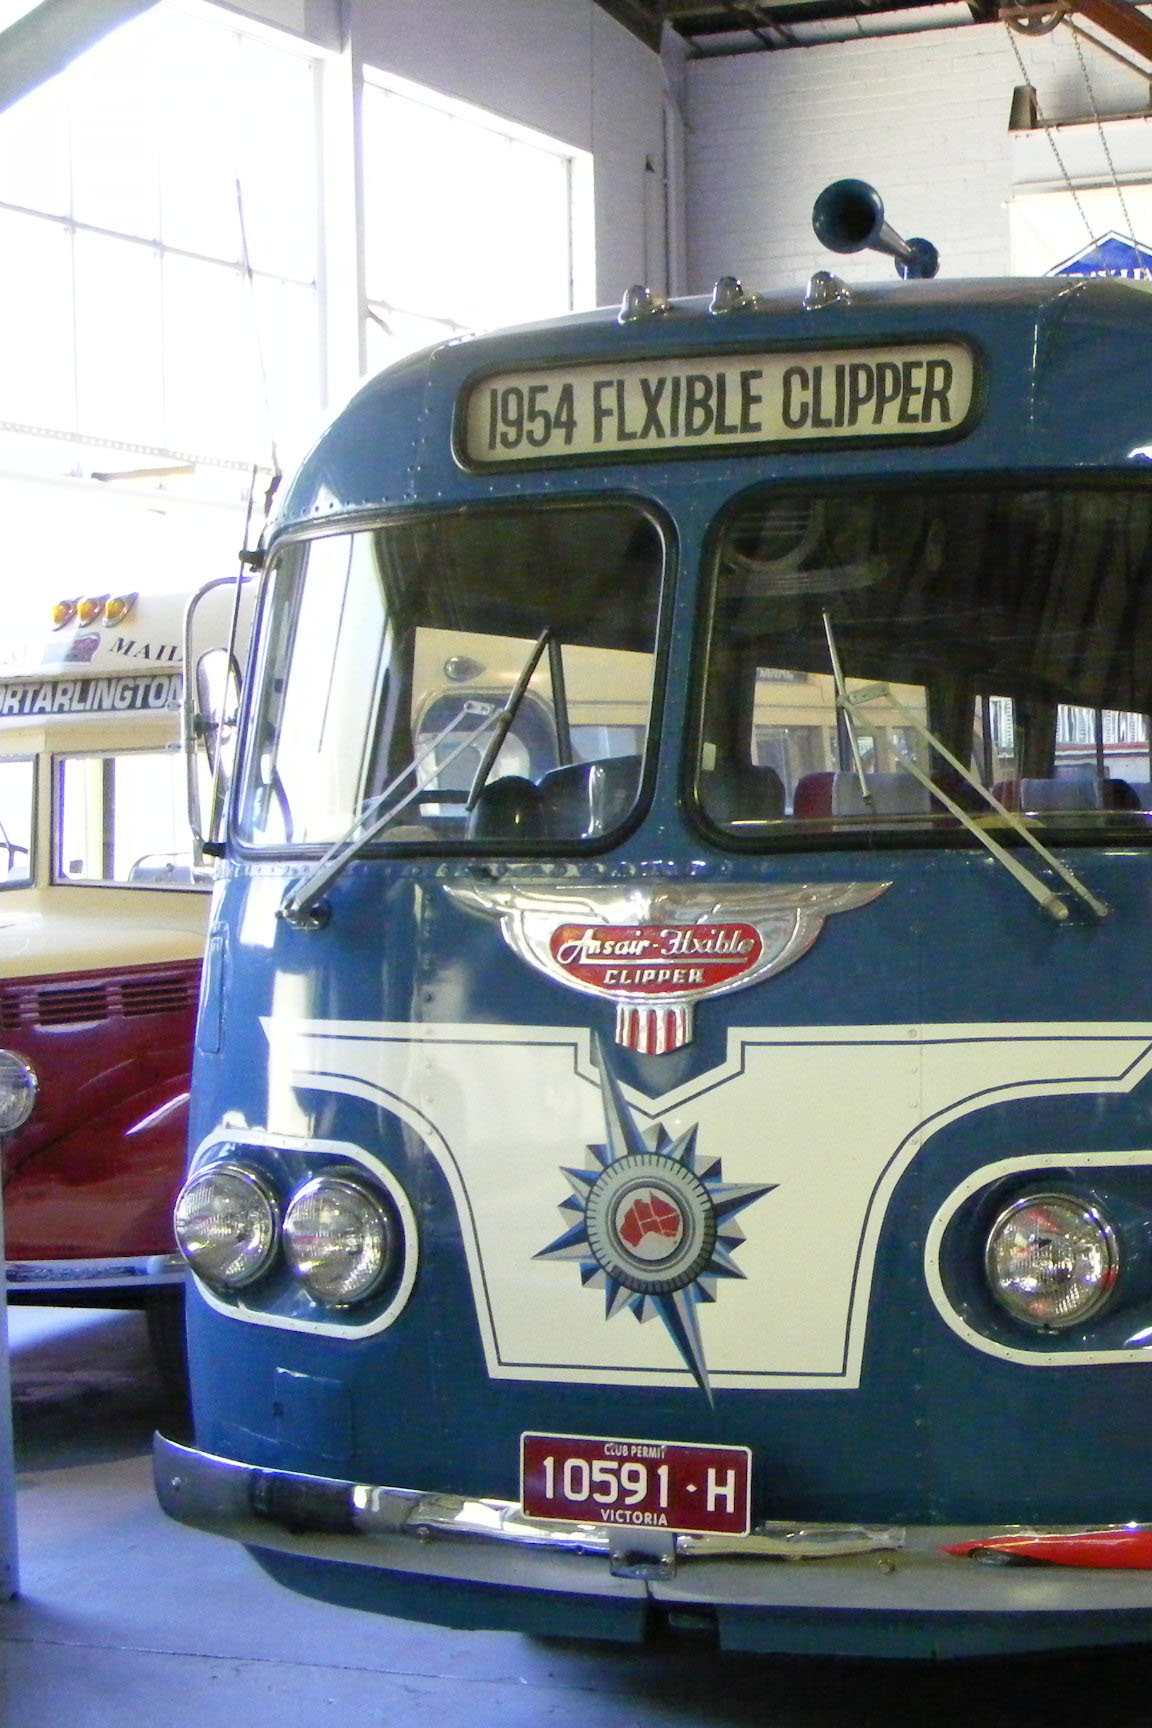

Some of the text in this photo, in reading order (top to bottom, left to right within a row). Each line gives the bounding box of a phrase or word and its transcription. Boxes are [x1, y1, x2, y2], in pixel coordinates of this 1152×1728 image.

[488, 359, 953, 449] 1954 FLXIBLE CLIPPER
[110, 637, 183, 662] MAIL
[603, 969, 705, 984] CLIPPER
[604, 1442, 666, 1459] CLUB PERMIT
[600, 1508, 668, 1526] VICTORIA
